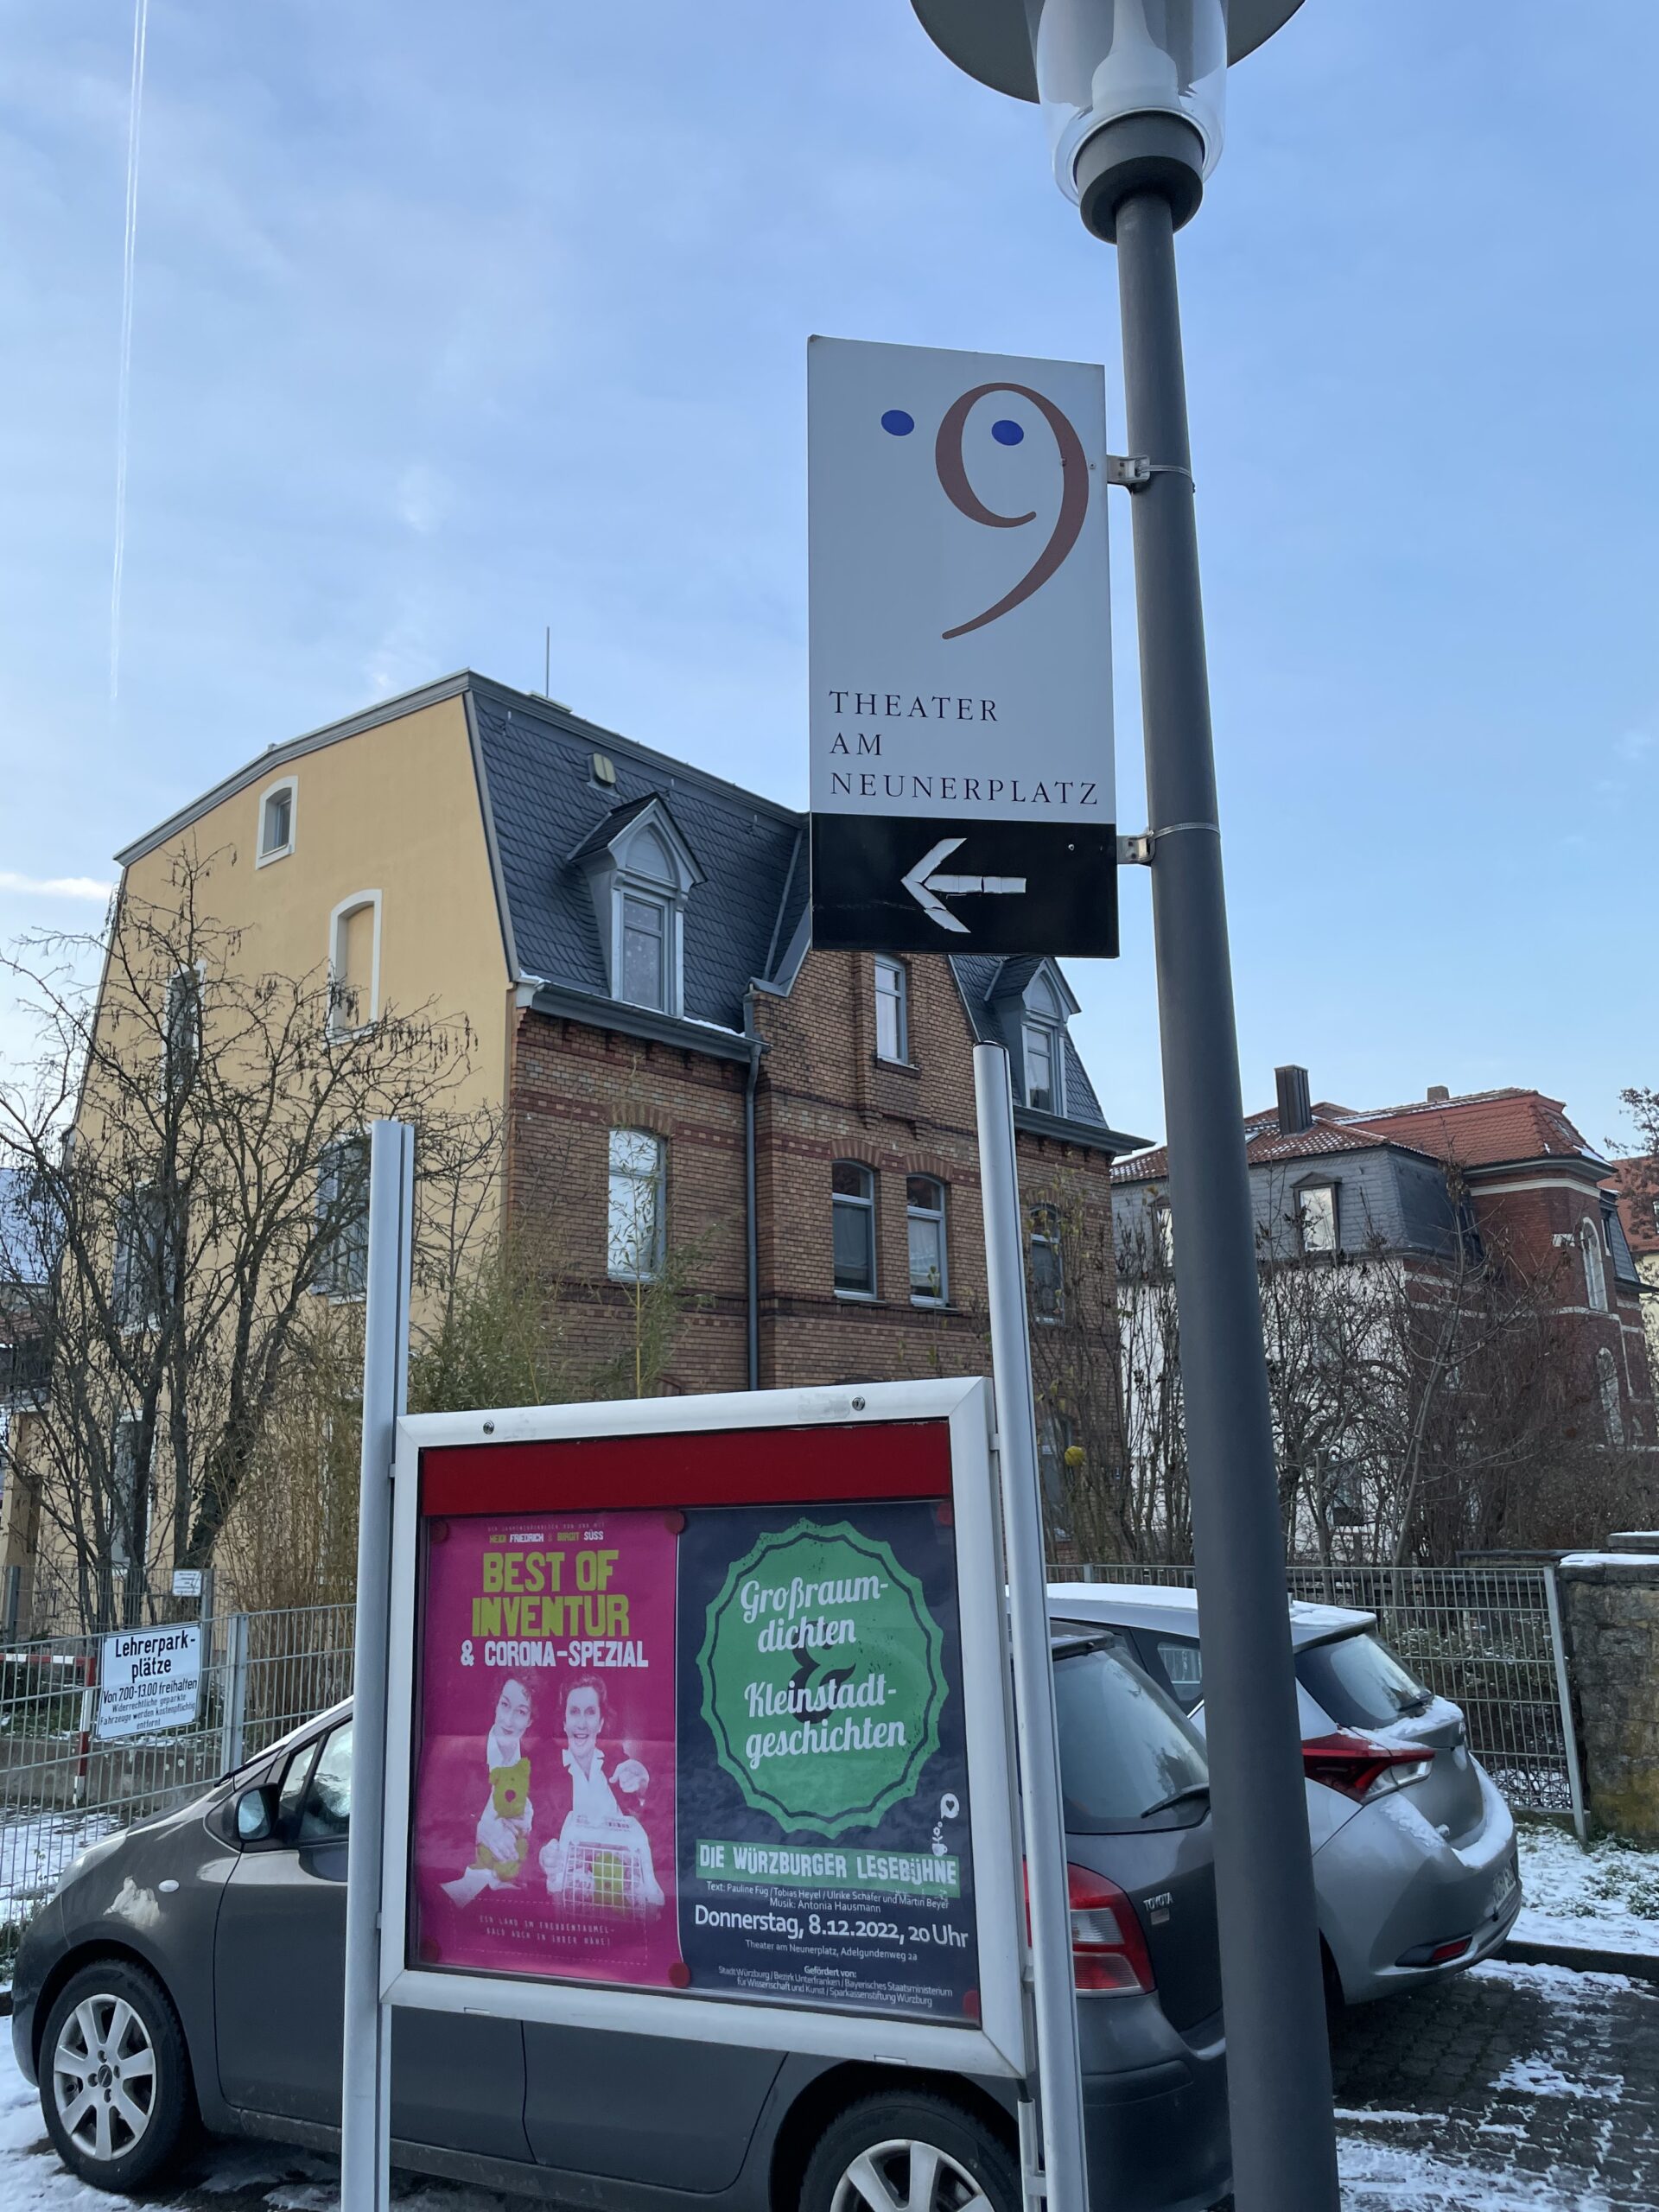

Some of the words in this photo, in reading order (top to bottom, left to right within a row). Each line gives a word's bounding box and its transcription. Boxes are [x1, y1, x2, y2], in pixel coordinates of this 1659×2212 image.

[829, 690, 998, 721] THEATER
[829, 733, 882, 755] AM
[830, 772, 1097, 804] NEUNERPLATZ
[509, 1533, 544, 1543] FRIEDRICH
[583, 1529, 604, 1541] SÜSS
[483, 1552, 565, 1592] BEST
[575, 1549, 619, 1592] OF
[741, 1575, 888, 1624] Großraum-
[472, 1594, 630, 1637] INVENTUR
[115, 1630, 195, 1657] Lehrerpark-
[758, 1616, 856, 1653] dichten
[461, 1640, 474, 1667] &
[485, 1640, 649, 1667] CORONA-SPEZIAL
[131, 1657, 171, 1683] plätze
[104, 1689, 117, 1704] Von
[159, 1678, 197, 1694] freihalten
[112, 1698, 157, 1713] Widerrechtliche
[160, 1694, 187, 1707] geparkte
[744, 1673, 896, 1718] Kleinstadt-
[100, 1714, 131, 1726] Fahrzeuge
[133, 1710, 154, 1720] werden
[137, 1719, 161, 1730] entfernt
[746, 1717, 906, 1770] geschichten
[700, 1844, 725, 1869] DIE
[733, 1847, 847, 1878] WÜRZBURGER
[857, 1854, 957, 1885] LESEBÜHNE
[707, 1881, 725, 1891] Text:
[728, 1884, 753, 1894] Pauline
[774, 1887, 798, 1898] Tobias
[798, 1890, 821, 1902] Heyel
[827, 1891, 850, 1900] Ulrike
[883, 1893, 897, 1904] und
[899, 1895, 925, 1907] Martin
[926, 1897, 950, 1910] Beyer
[770, 1898, 796, 1909] Musik:
[798, 1900, 833, 1910] Antonia
[834, 1902, 880, 1913] Hausmann
[1143, 1892, 1173, 1910] TOYOTA
[695, 1904, 804, 1939] Donnerstag,
[809, 1913, 905, 1945] 8.12.2022,
[908, 1926, 931, 1942] 20
[932, 1923, 969, 1948] Uhr
[745, 1939, 774, 1950] Theater
[789, 1944, 839, 1957] Neunerplatz,
[841, 1946, 906, 1962] Adelgundenweg
[718, 1966, 735, 1975] Stadt
[774, 1972, 794, 1982] Bezirk
[795, 1974, 840, 1986] Unterfranken
[845, 1979, 887, 1991] Bayerisches
[887, 1981, 953, 1997] Staatsministerium
[804, 1966, 839, 1977] Gefördert
[747, 1978, 790, 1991] Wissenschaft
[791, 1983, 805, 1992] und
[805, 1986, 825, 1995] Kunst
[830, 1987, 896, 2004] Sparkassenstiftung
